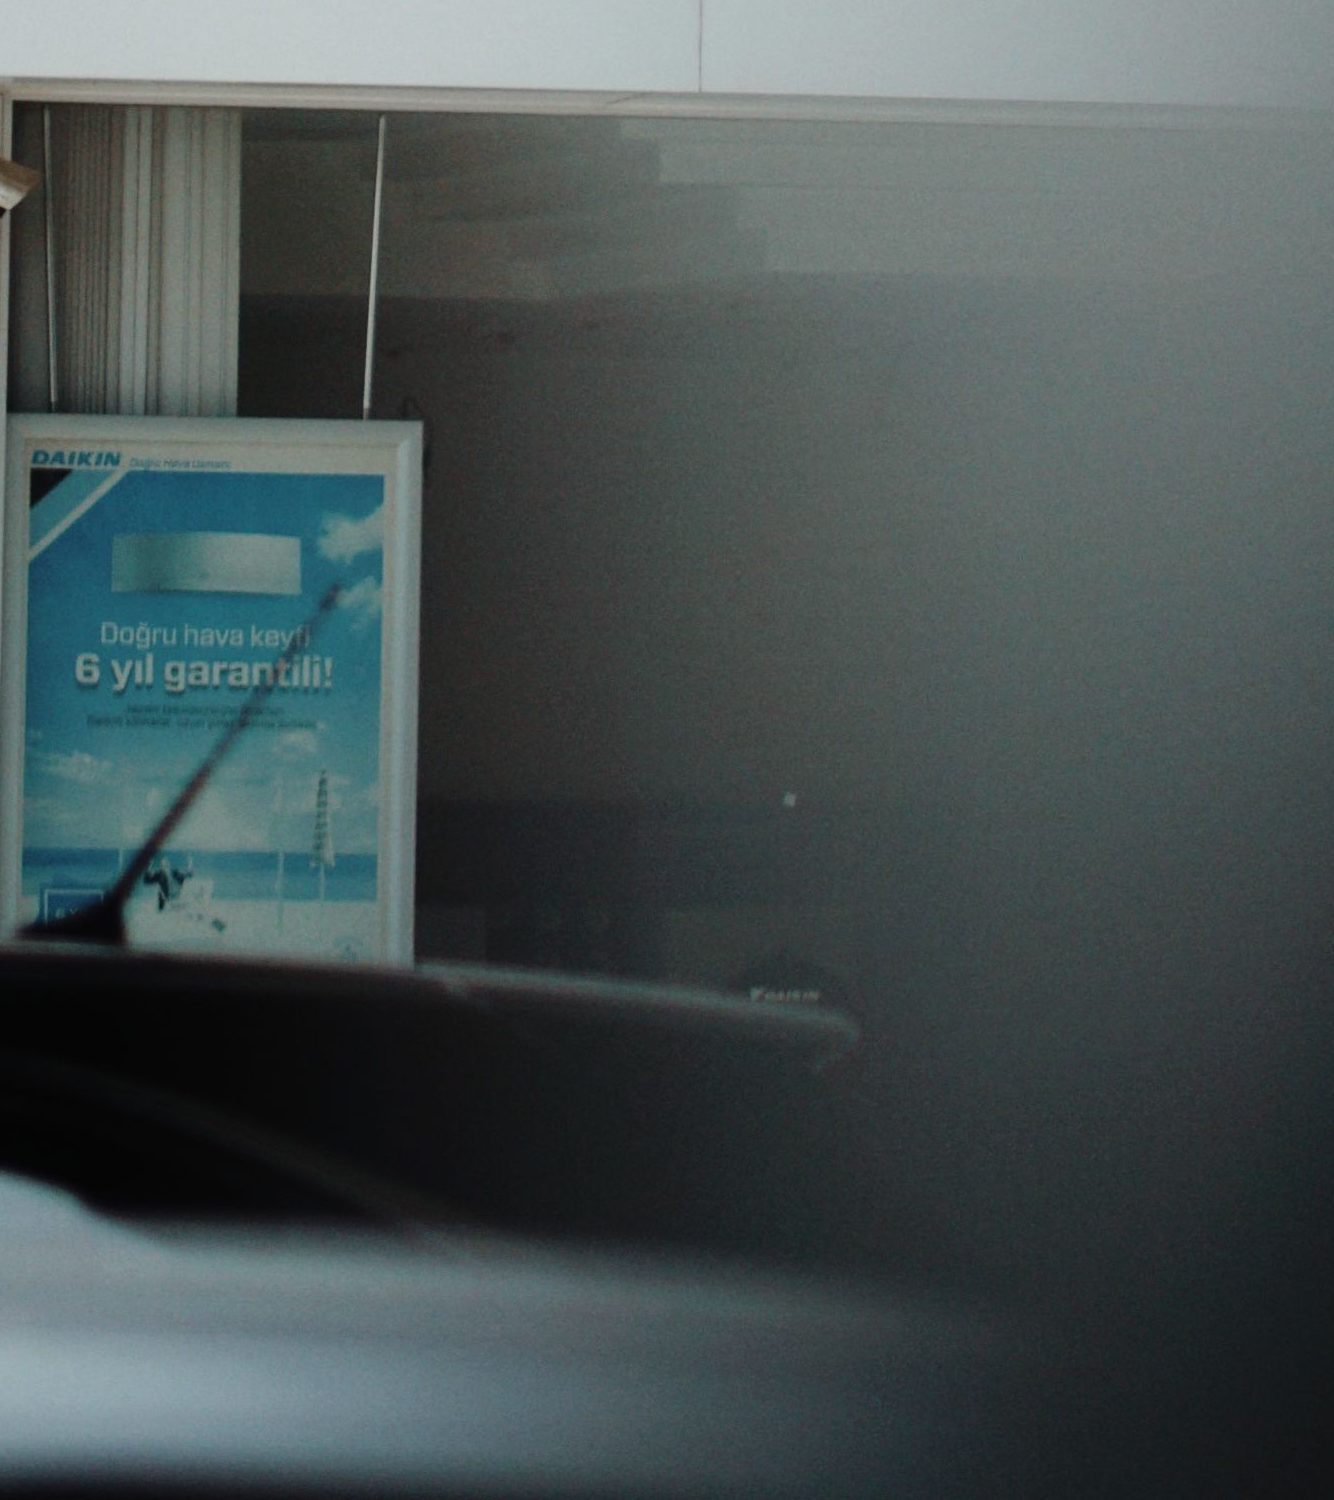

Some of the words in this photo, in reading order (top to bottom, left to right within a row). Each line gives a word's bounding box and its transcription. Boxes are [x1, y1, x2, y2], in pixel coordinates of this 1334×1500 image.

[30, 449, 122, 468] DAIKIN
[100, 621, 178, 650] Doğru
[184, 624, 244, 646] hava
[74, 653, 101, 685] 6
[110, 652, 154, 691] yıl
[163, 654, 334, 691] garantili!
